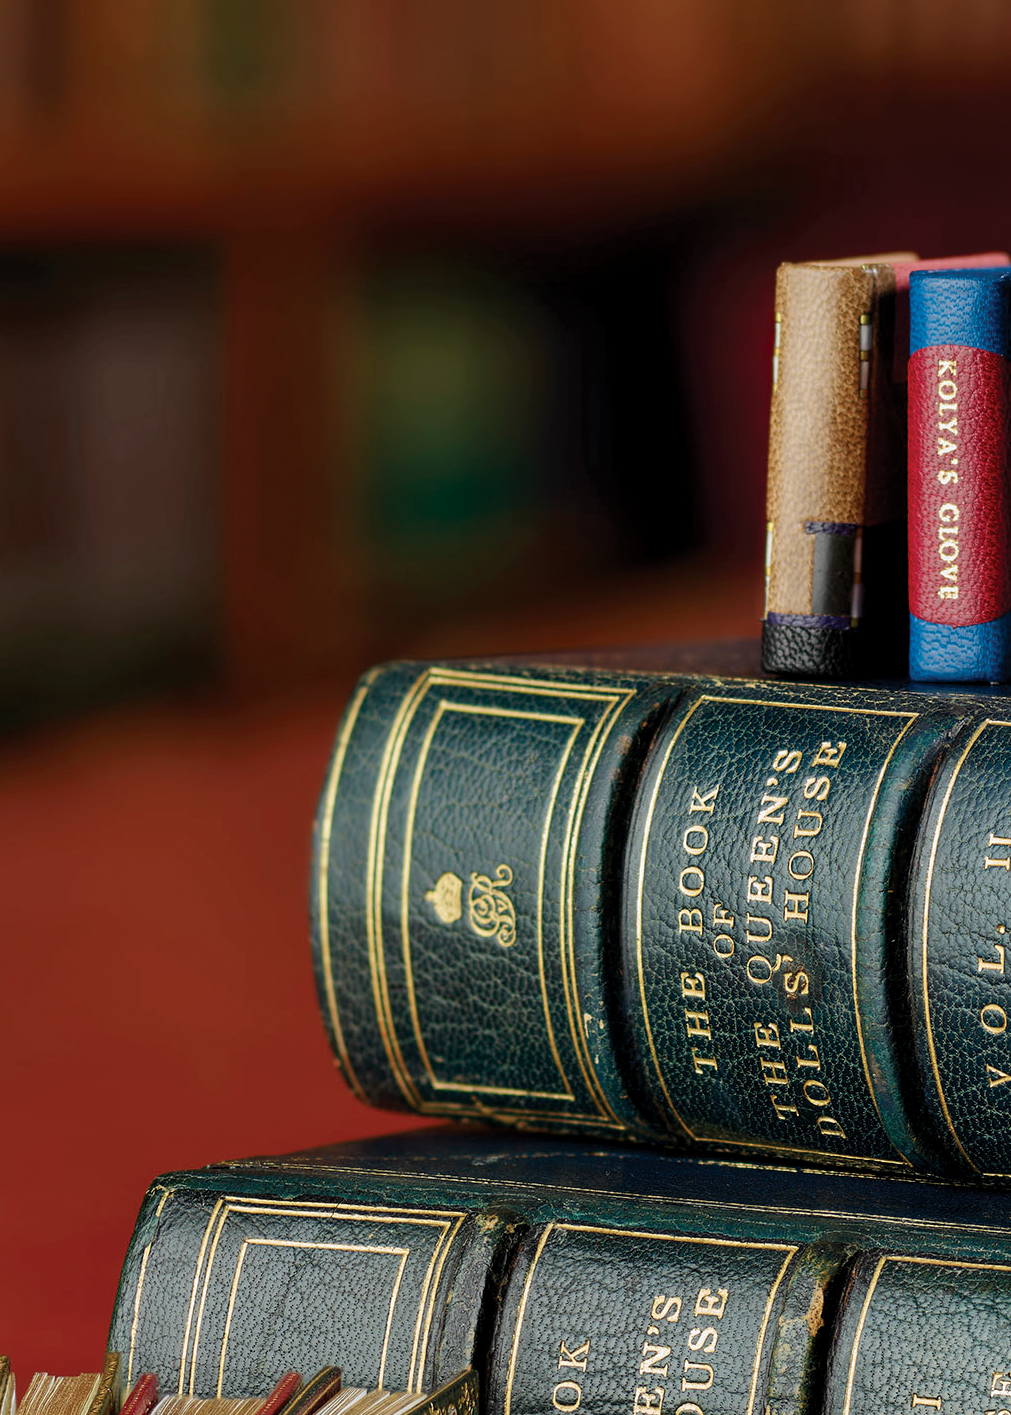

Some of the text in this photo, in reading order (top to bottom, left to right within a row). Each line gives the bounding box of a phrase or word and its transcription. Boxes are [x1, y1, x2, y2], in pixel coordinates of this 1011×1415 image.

[937, 359, 960, 601] KOLYA'S GLOVE
[679, 784, 721, 1075] THE BOOK
[713, 903, 735, 958] OF
[747, 749, 802, 1120] THE QUEEN'S
[784, 741, 847, 924] HOUSE
